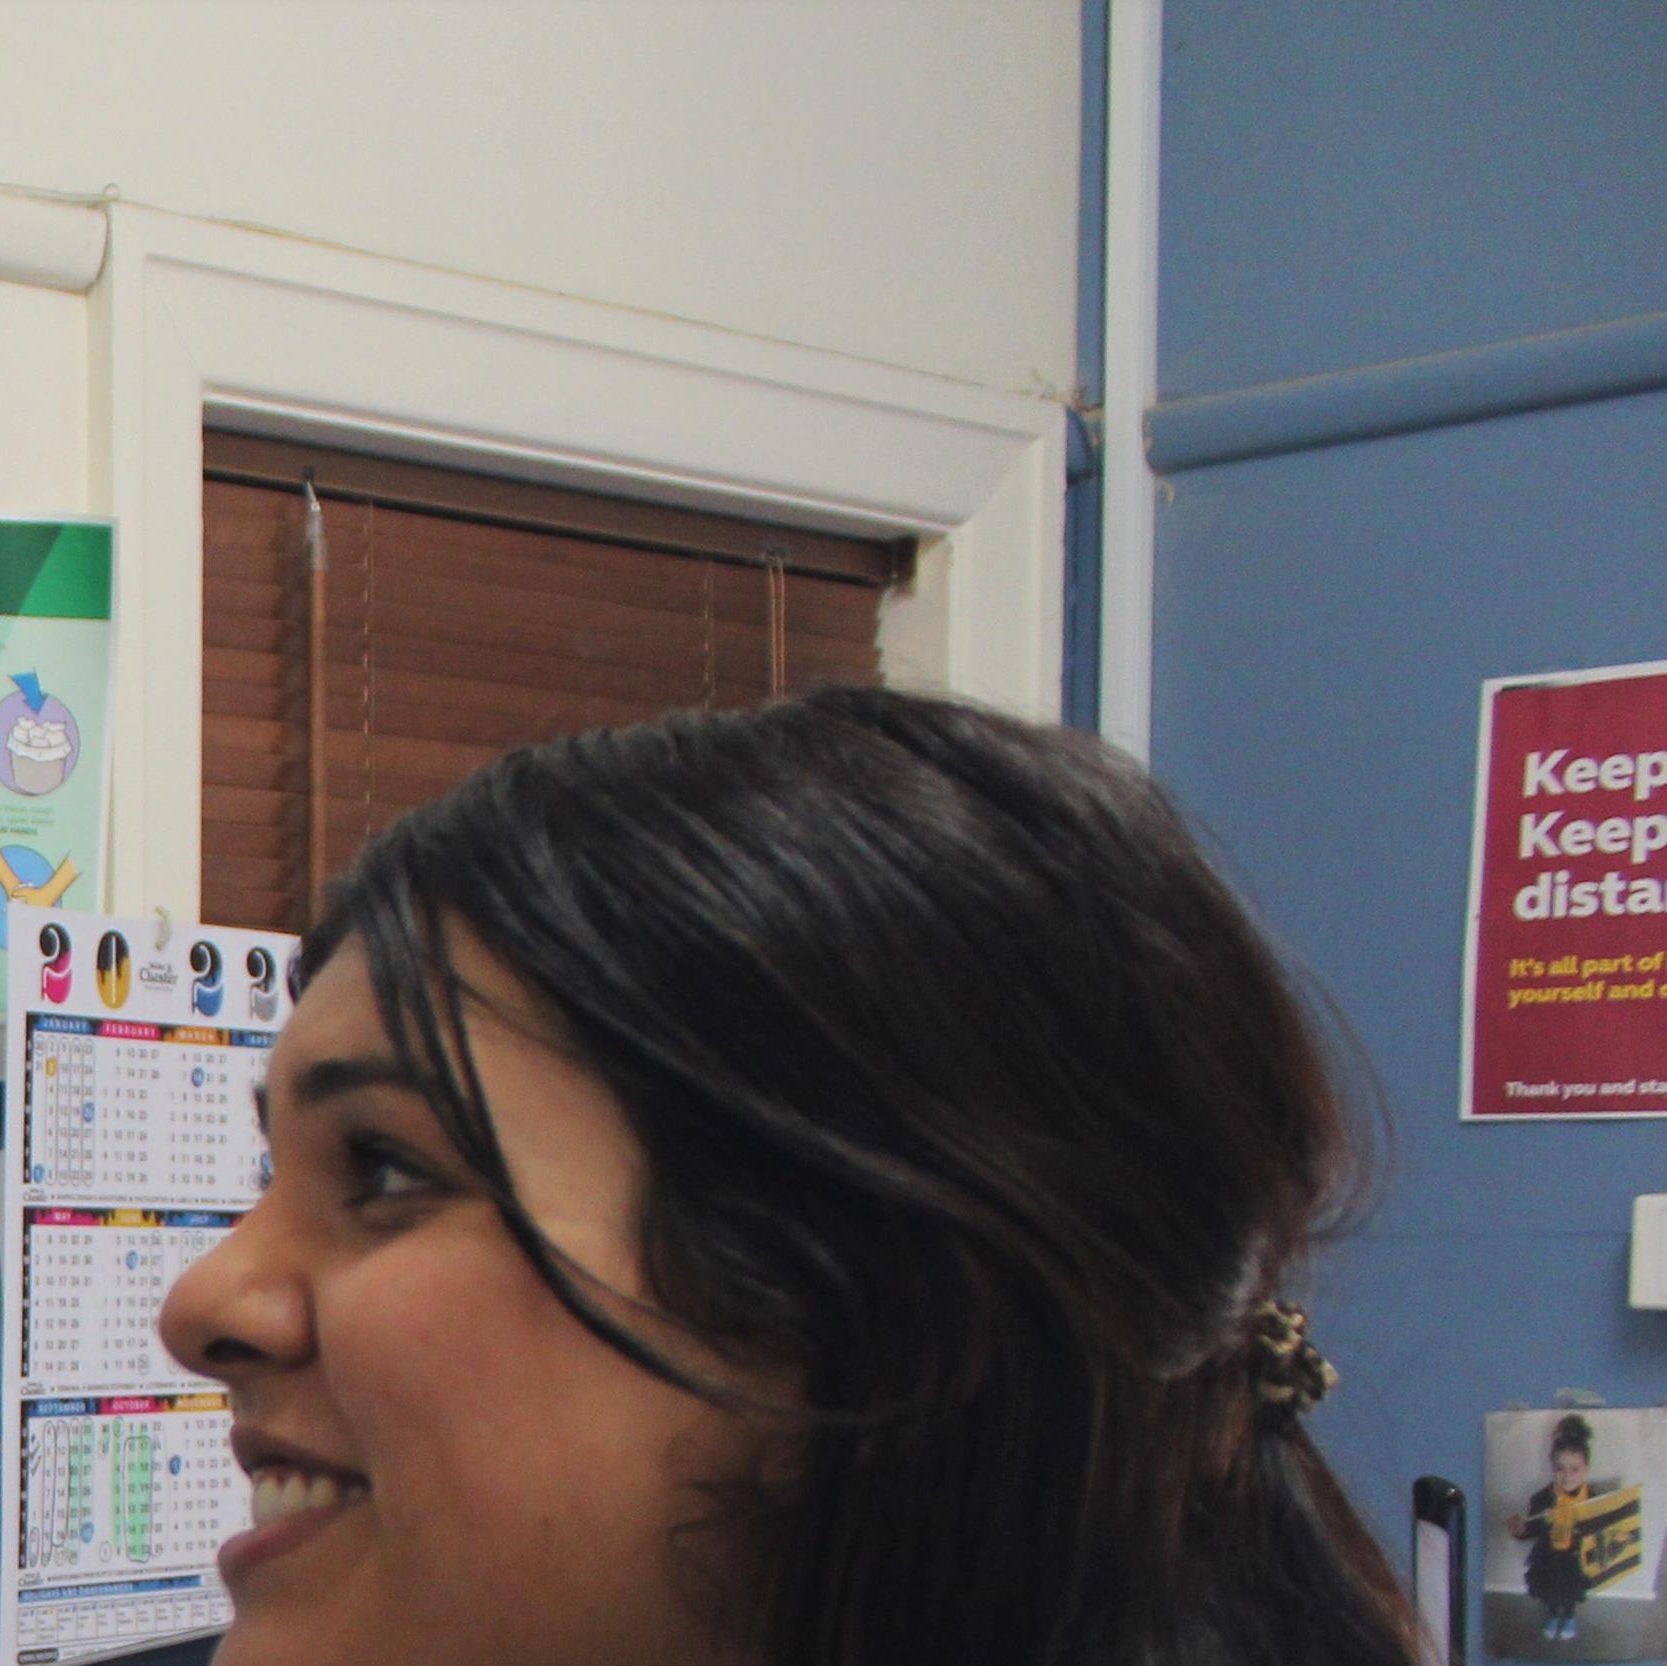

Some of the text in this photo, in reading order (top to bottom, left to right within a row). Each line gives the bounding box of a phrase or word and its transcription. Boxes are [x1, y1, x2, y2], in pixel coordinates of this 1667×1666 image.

[1522, 748, 1667, 801] Keep
[1518, 810, 1667, 865] Keep
[1512, 869, 1667, 922] dista
[1510, 951, 1666, 980] It's all part of
[1508, 978, 1655, 1010] yourself and
[1505, 1080, 1560, 1098] Thank
[1562, 1083, 1598, 1101] you
[1598, 1079, 1636, 1096] and
